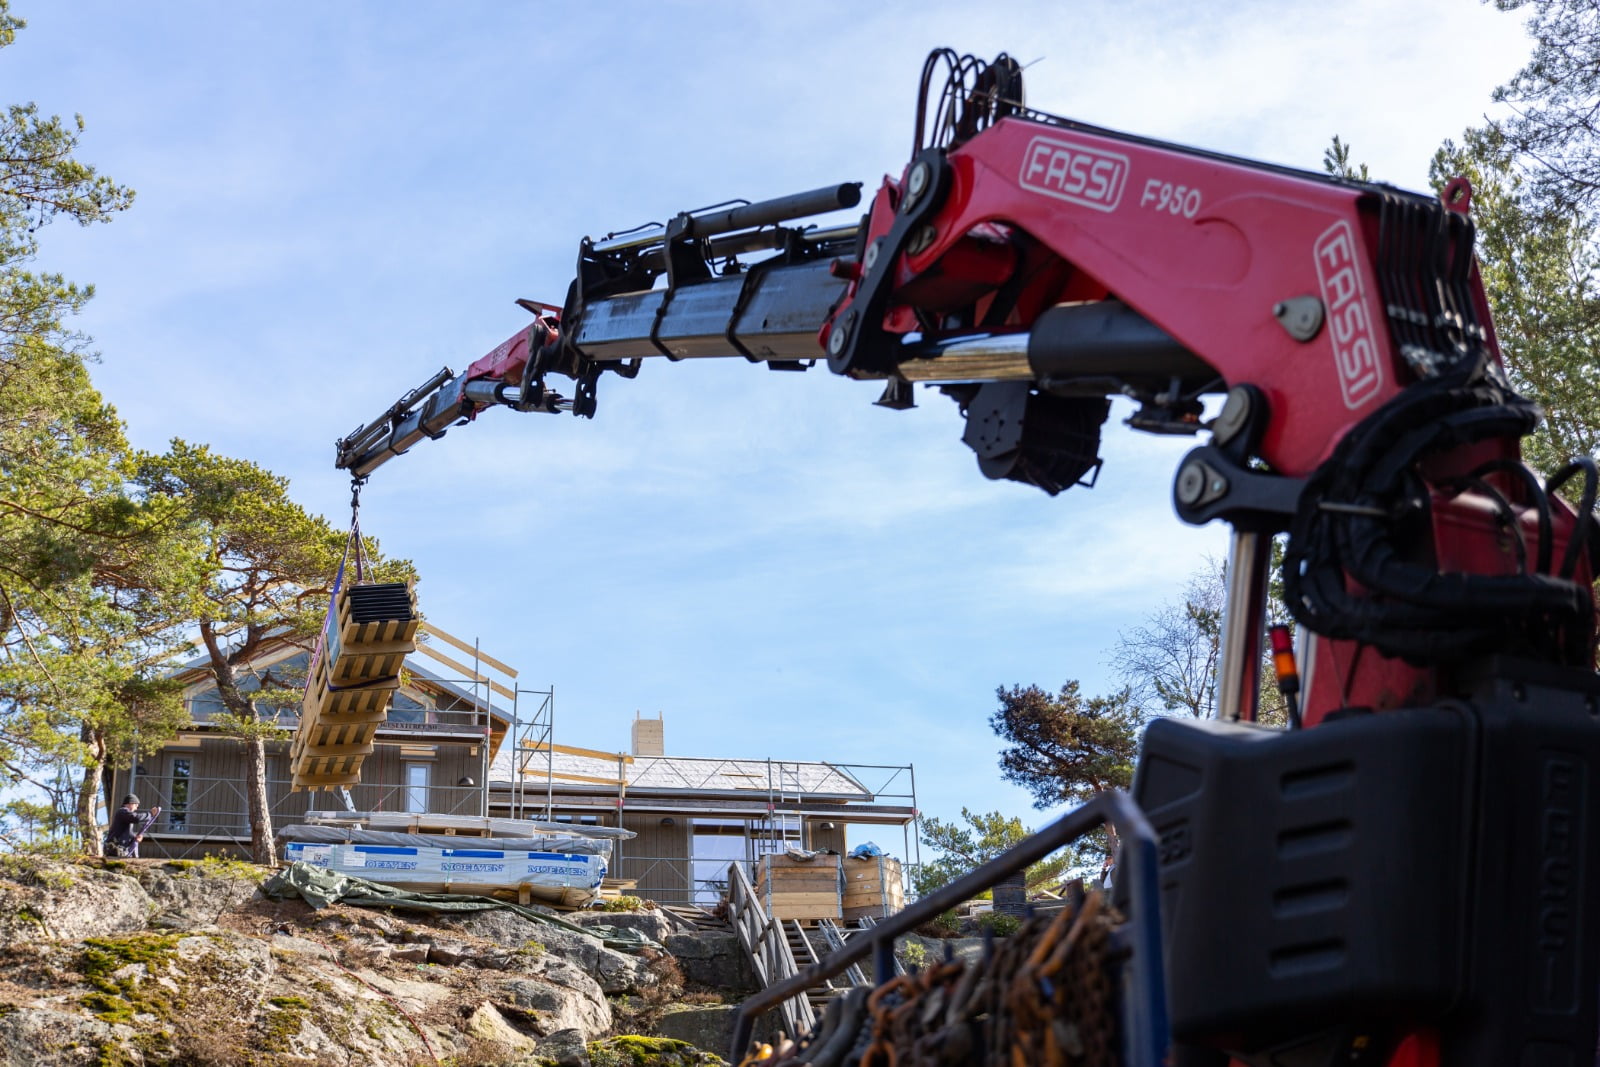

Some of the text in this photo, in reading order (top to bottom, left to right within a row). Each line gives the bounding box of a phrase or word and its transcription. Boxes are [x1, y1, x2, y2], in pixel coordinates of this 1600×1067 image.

[1026, 145, 1121, 203] FASSI
[1140, 179, 1201, 219] F950
[1320, 233, 1376, 399] FASSI
[365, 860, 417, 870] OELVEN
[441, 862, 504, 872] MOELVEN
[528, 865, 588, 876] MOELVEN
